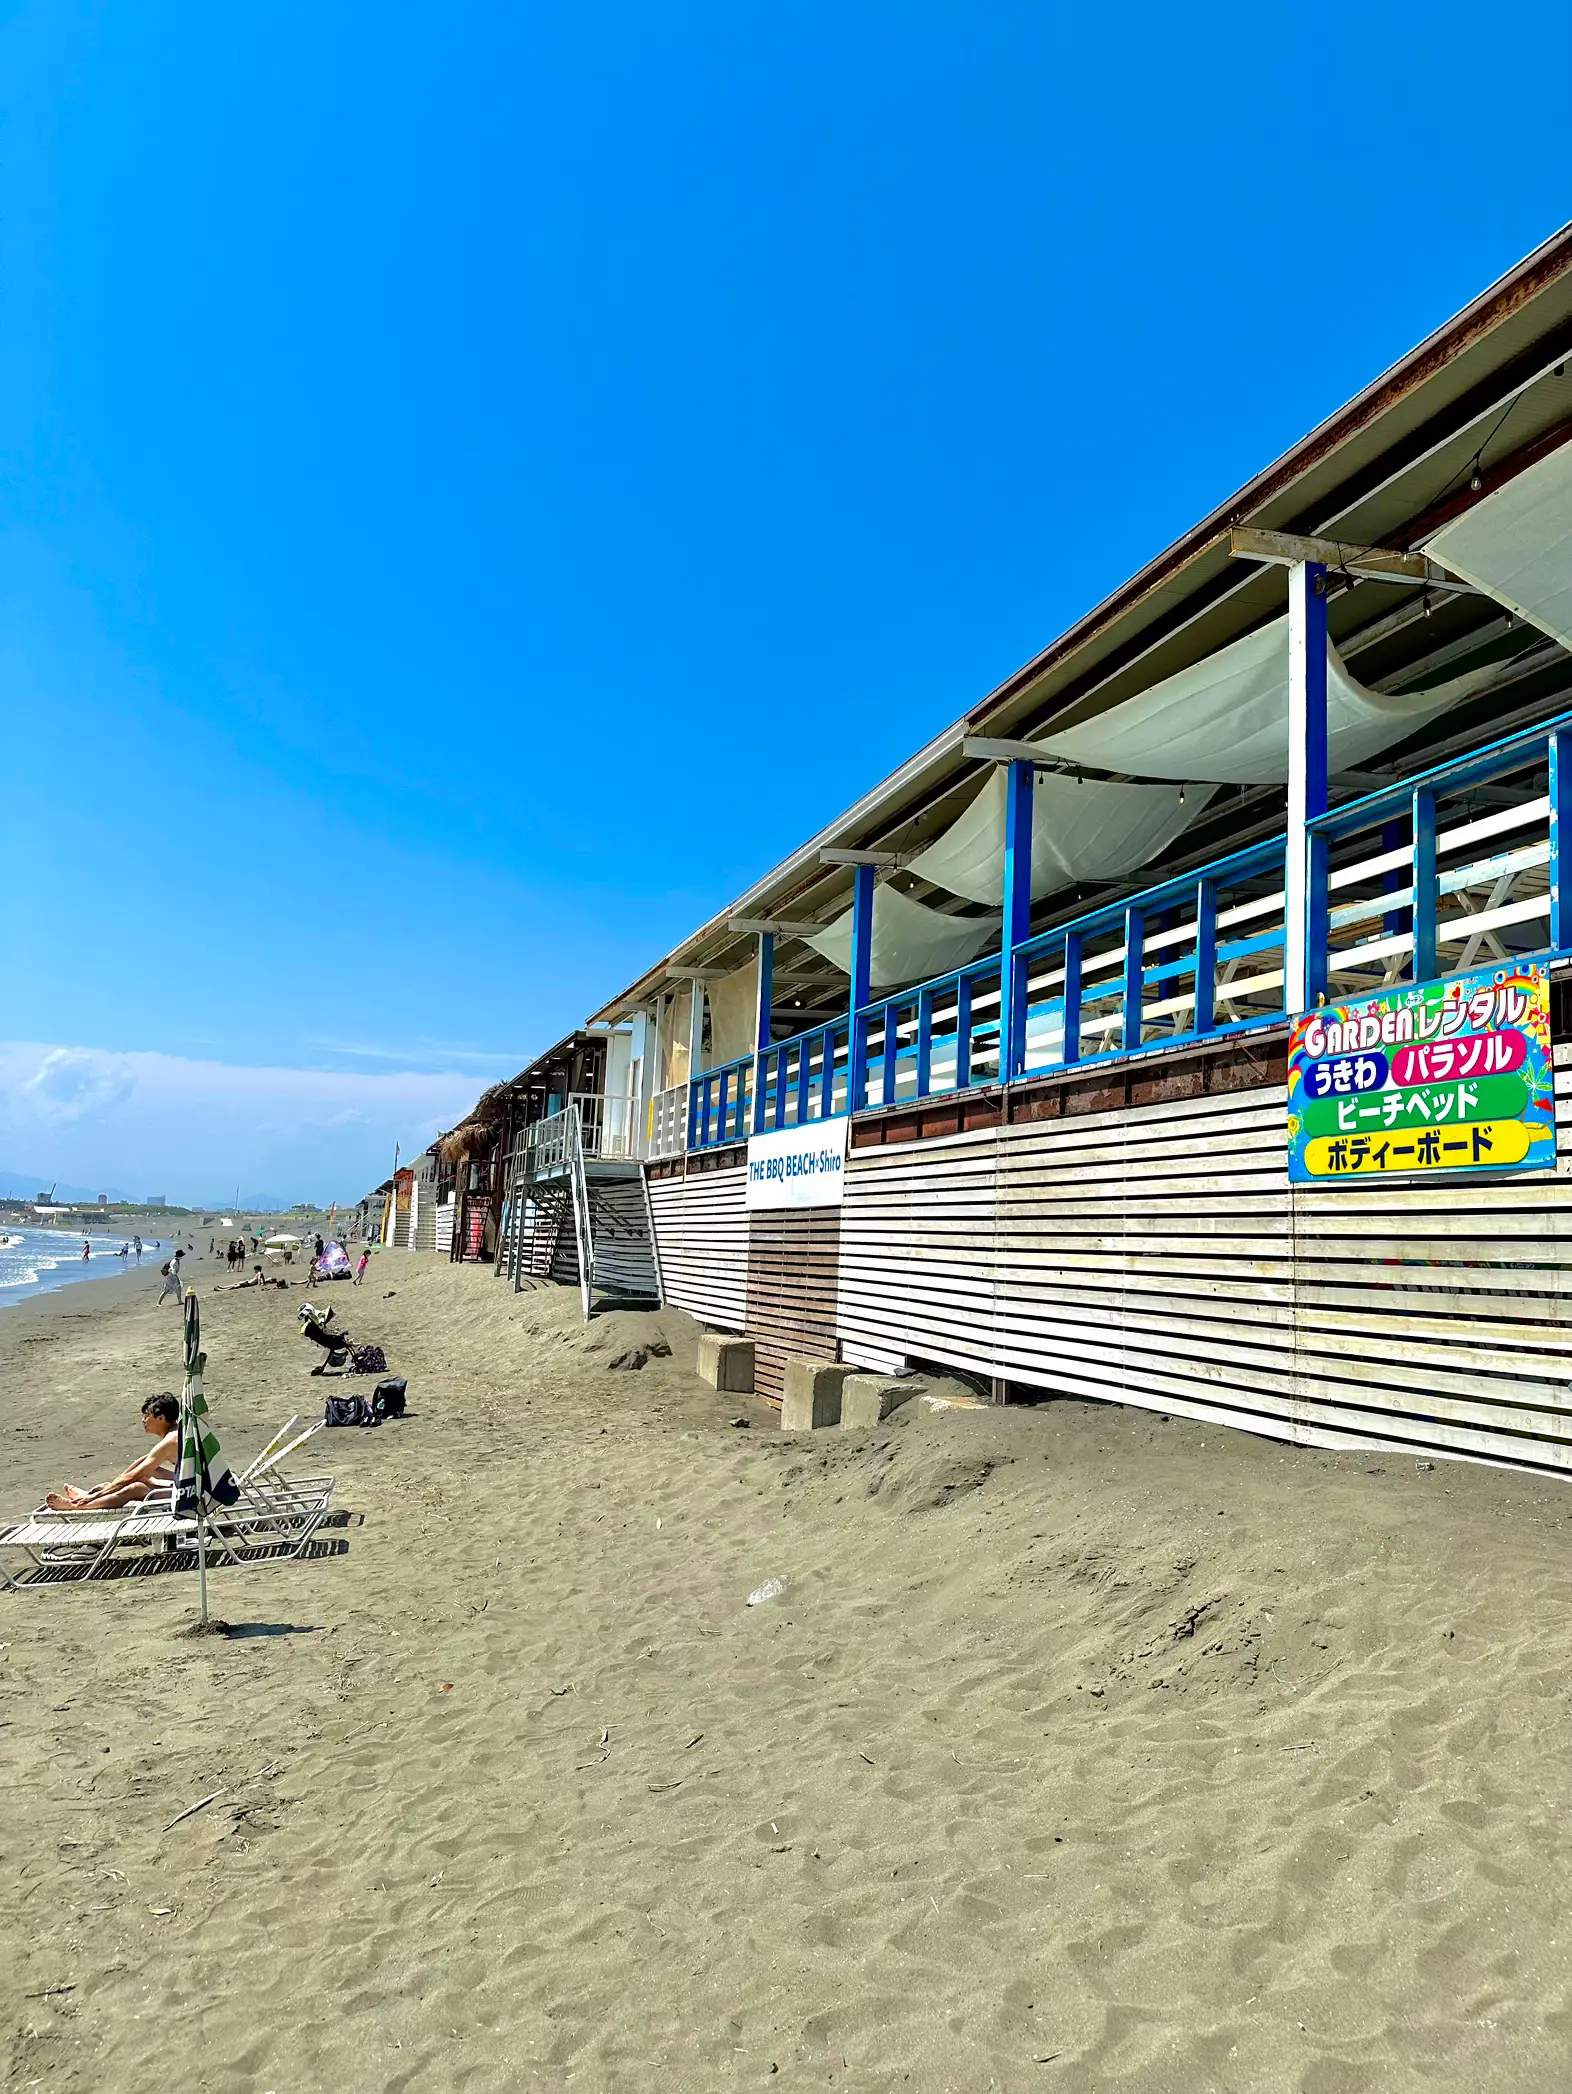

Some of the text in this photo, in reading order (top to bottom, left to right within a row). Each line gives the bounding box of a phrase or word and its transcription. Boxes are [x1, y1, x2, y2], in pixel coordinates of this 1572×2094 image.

[1315, 1057, 1377, 1096] うきわ
[1404, 1034, 1513, 1082] パラソル
[1337, 1081, 1479, 1131] ビーチベッド
[749, 1160, 765, 1182] THE
[766, 1156, 784, 1183] BBQ
[1327, 1126, 1494, 1171] ボディーボード
